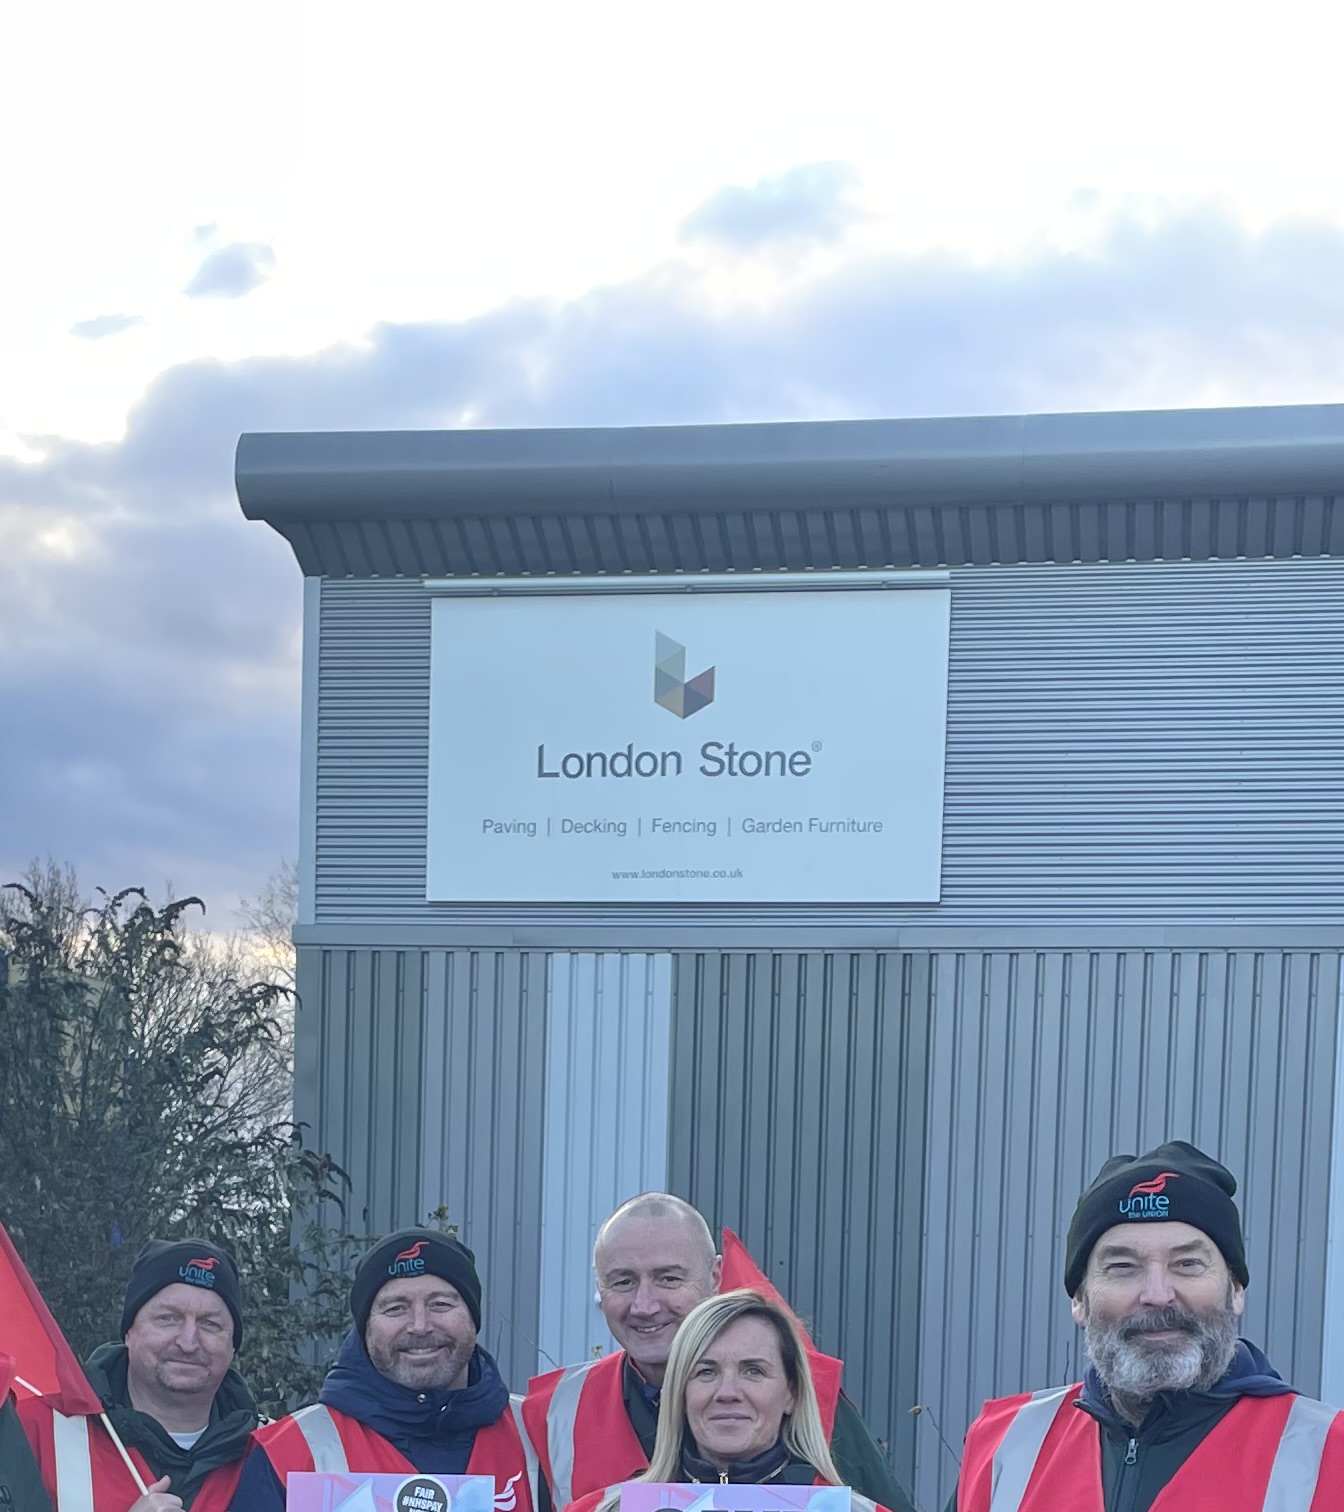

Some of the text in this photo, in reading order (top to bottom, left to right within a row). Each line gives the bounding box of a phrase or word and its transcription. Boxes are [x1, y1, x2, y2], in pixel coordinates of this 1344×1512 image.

[537, 742, 682, 779] London
[482, 817, 884, 838] Paving Decking Fencing Garden Furniture
[611, 866, 744, 880] www.londonstone.co.uk
[1119, 1192, 1170, 1214] unite
[179, 1265, 215, 1281] unite
[388, 1258, 425, 1276] unite
[414, 1486, 435, 1500] FAIR
[401, 1495, 443, 1512] #NHSPAY
